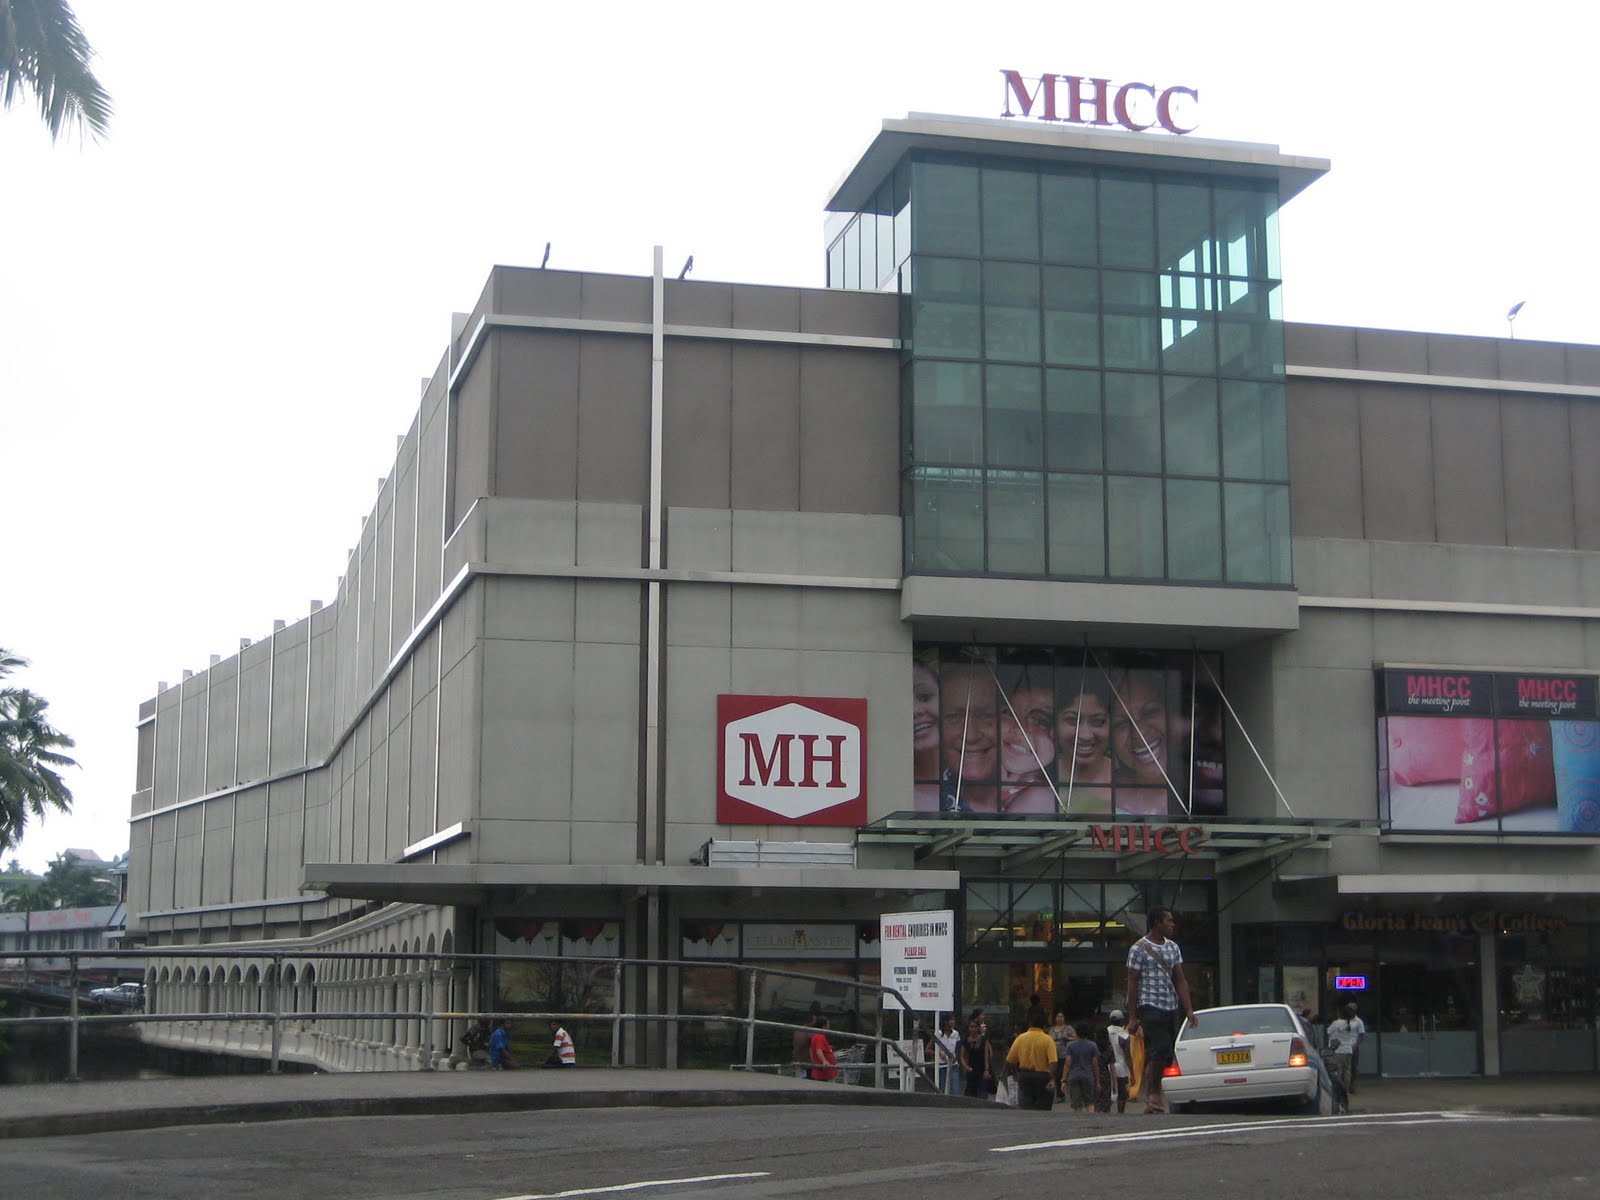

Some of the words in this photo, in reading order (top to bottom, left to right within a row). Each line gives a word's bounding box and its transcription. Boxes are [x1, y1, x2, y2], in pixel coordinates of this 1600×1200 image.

[999, 69, 1199, 135] MHCC
[1408, 675, 1471, 698] MHCC
[1518, 679, 1578, 702] MHCC
[1408, 693, 1420, 704] the
[1421, 697, 1451, 711] meeting
[1450, 697, 1470, 711] point
[1519, 696, 1529, 707] the
[1531, 700, 1558, 714] meeting
[1557, 700, 1576, 714] point
[739, 733, 846, 788] MH
[1089, 824, 1205, 854] MHCC
[893, 924, 907, 938] RENTAL
[908, 923, 929, 938] ENQUIRIES
[930, 922, 934, 936] IN
[935, 922, 948, 936] MHCC
[1343, 911, 1407, 931] Gloria
[904, 946, 918, 956] PLEASE
[918, 946, 927, 956] CALL
[1338, 977, 1363, 987] OPEN
